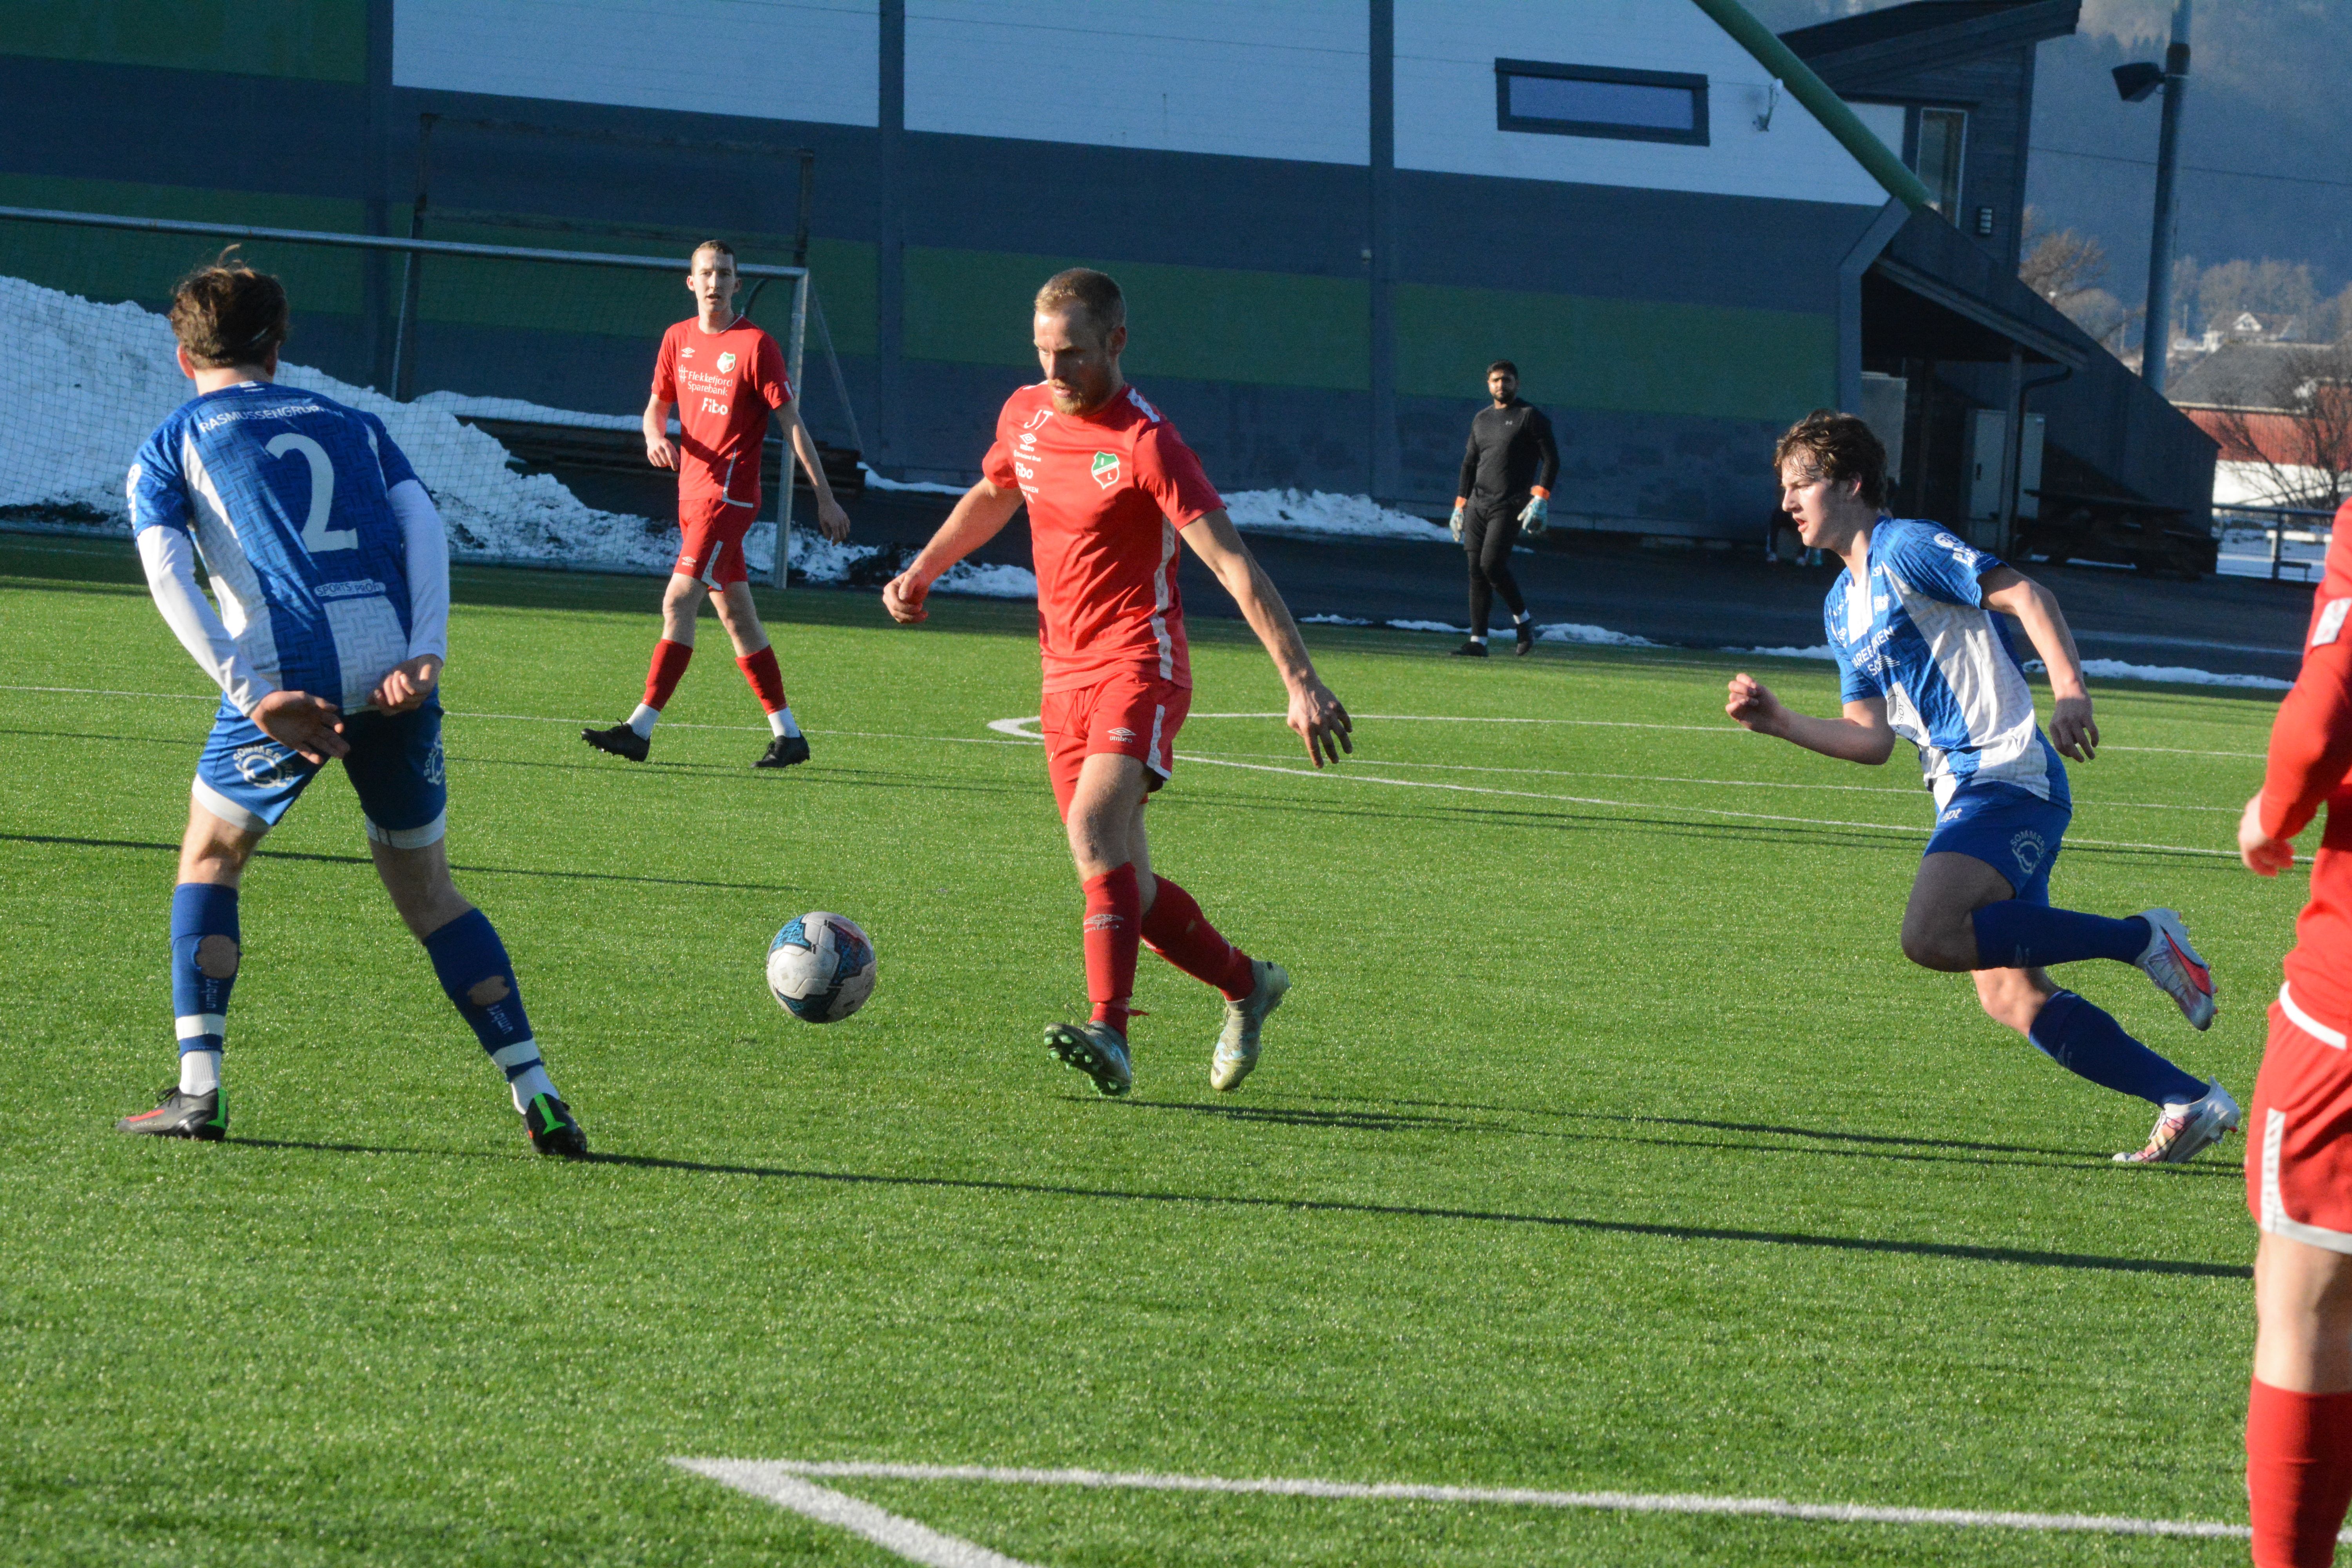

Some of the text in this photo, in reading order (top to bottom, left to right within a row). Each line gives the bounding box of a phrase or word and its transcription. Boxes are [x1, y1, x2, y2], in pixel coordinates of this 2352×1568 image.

[688, 371, 733, 387] Flekkefjord
[688, 381, 728, 396] Sparebank
[702, 397, 728, 416] Fibo
[1016, 461, 1033, 479] Fibo
[265, 433, 358, 552] 2
